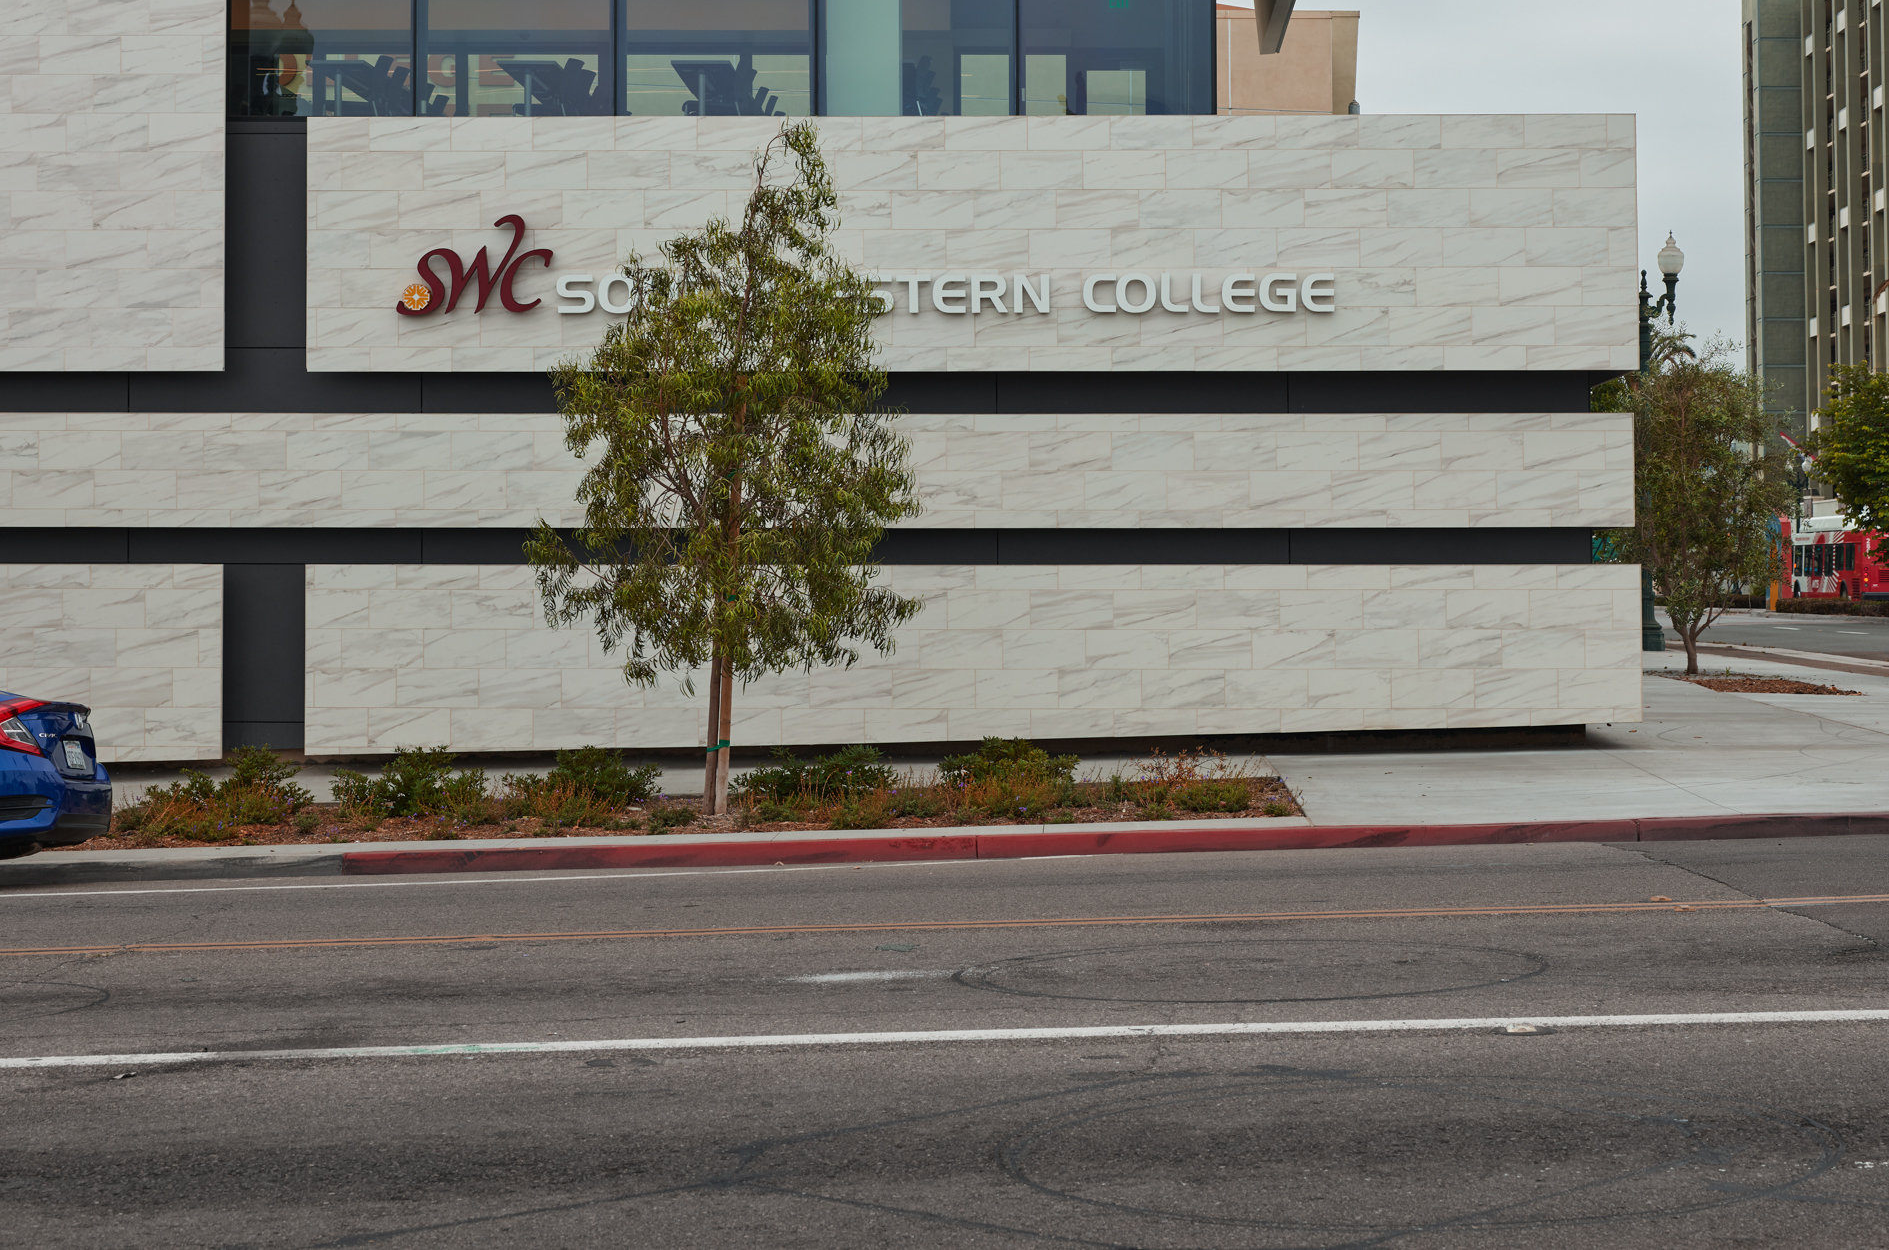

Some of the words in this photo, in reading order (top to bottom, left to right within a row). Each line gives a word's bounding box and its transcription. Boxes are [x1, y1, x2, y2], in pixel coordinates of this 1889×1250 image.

[396, 213, 554, 316] SWC
[556, 273, 1051, 315] SOSTERN
[1082, 272, 1336, 314] COLLEGE
